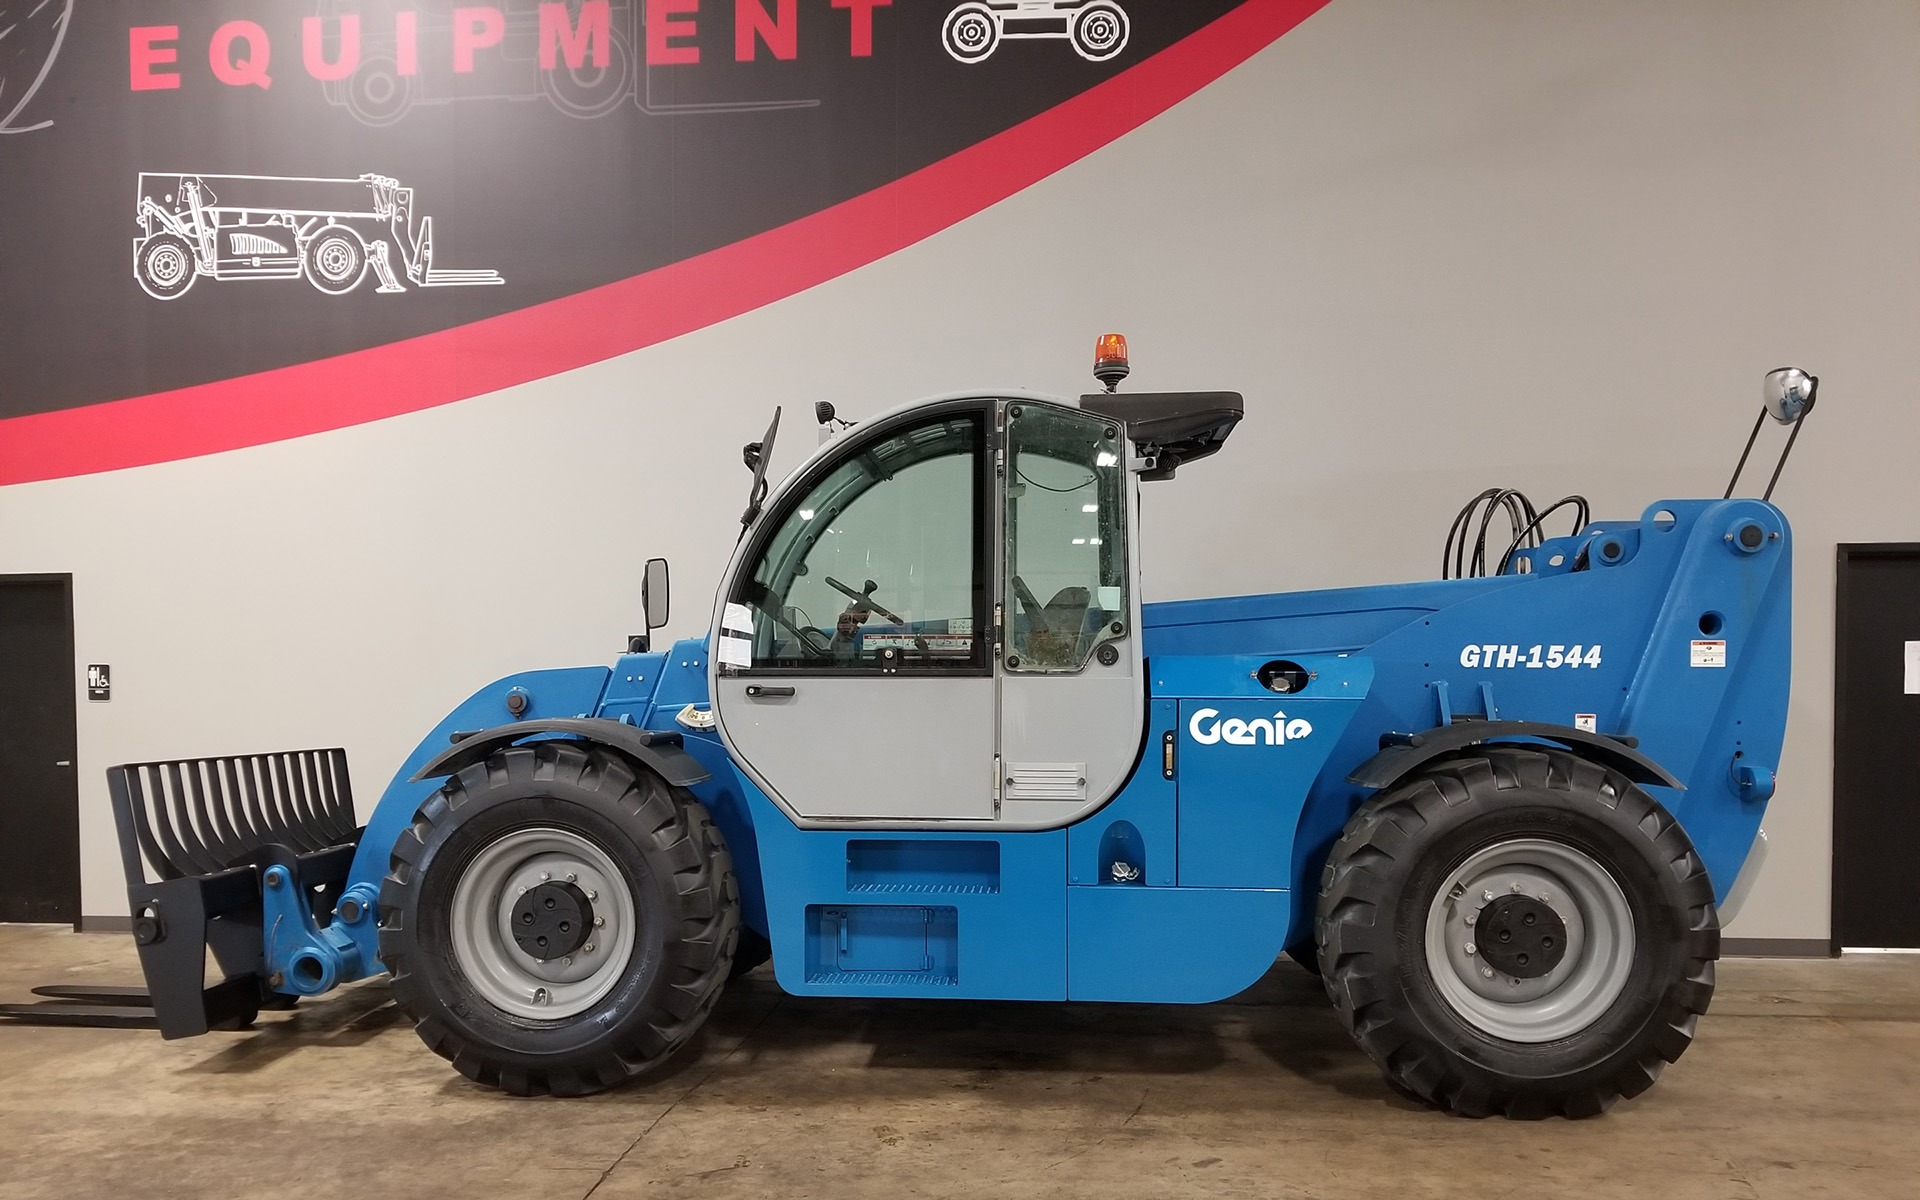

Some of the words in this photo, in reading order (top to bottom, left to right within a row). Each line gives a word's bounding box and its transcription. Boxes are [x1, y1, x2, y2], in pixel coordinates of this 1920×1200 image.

[129, 0, 892, 91] EQUIPMENT
[1460, 644, 1602, 669] GTH-1544
[1189, 707, 1313, 746] Genie
